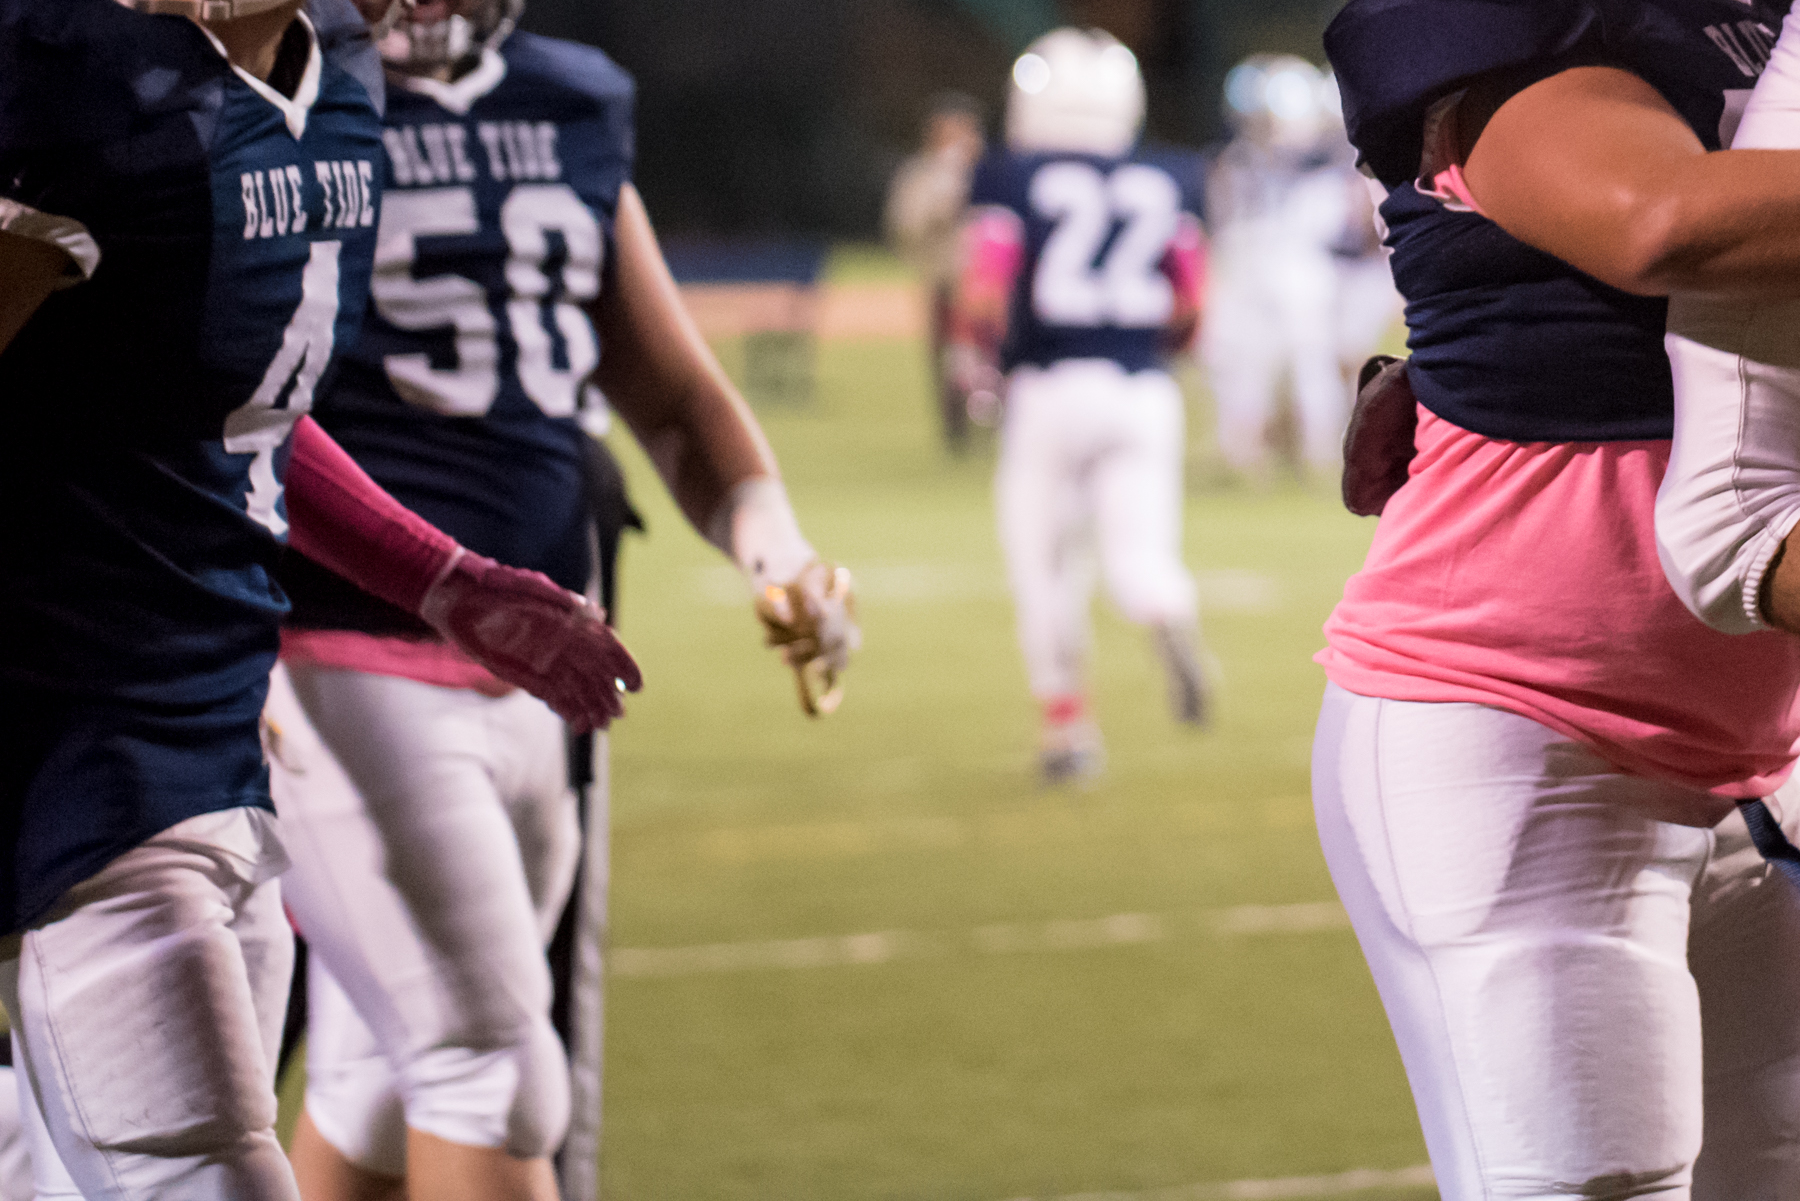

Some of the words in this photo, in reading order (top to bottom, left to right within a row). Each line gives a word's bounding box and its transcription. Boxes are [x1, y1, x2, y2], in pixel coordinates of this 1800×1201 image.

[241, 164, 307, 240] BLUE
[315, 160, 373, 230] TIDE
[383, 123, 477, 186] BLUE
[478, 121, 562, 182] TIDE
[370, 183, 604, 419] 50
[1029, 161, 1181, 329] 22
